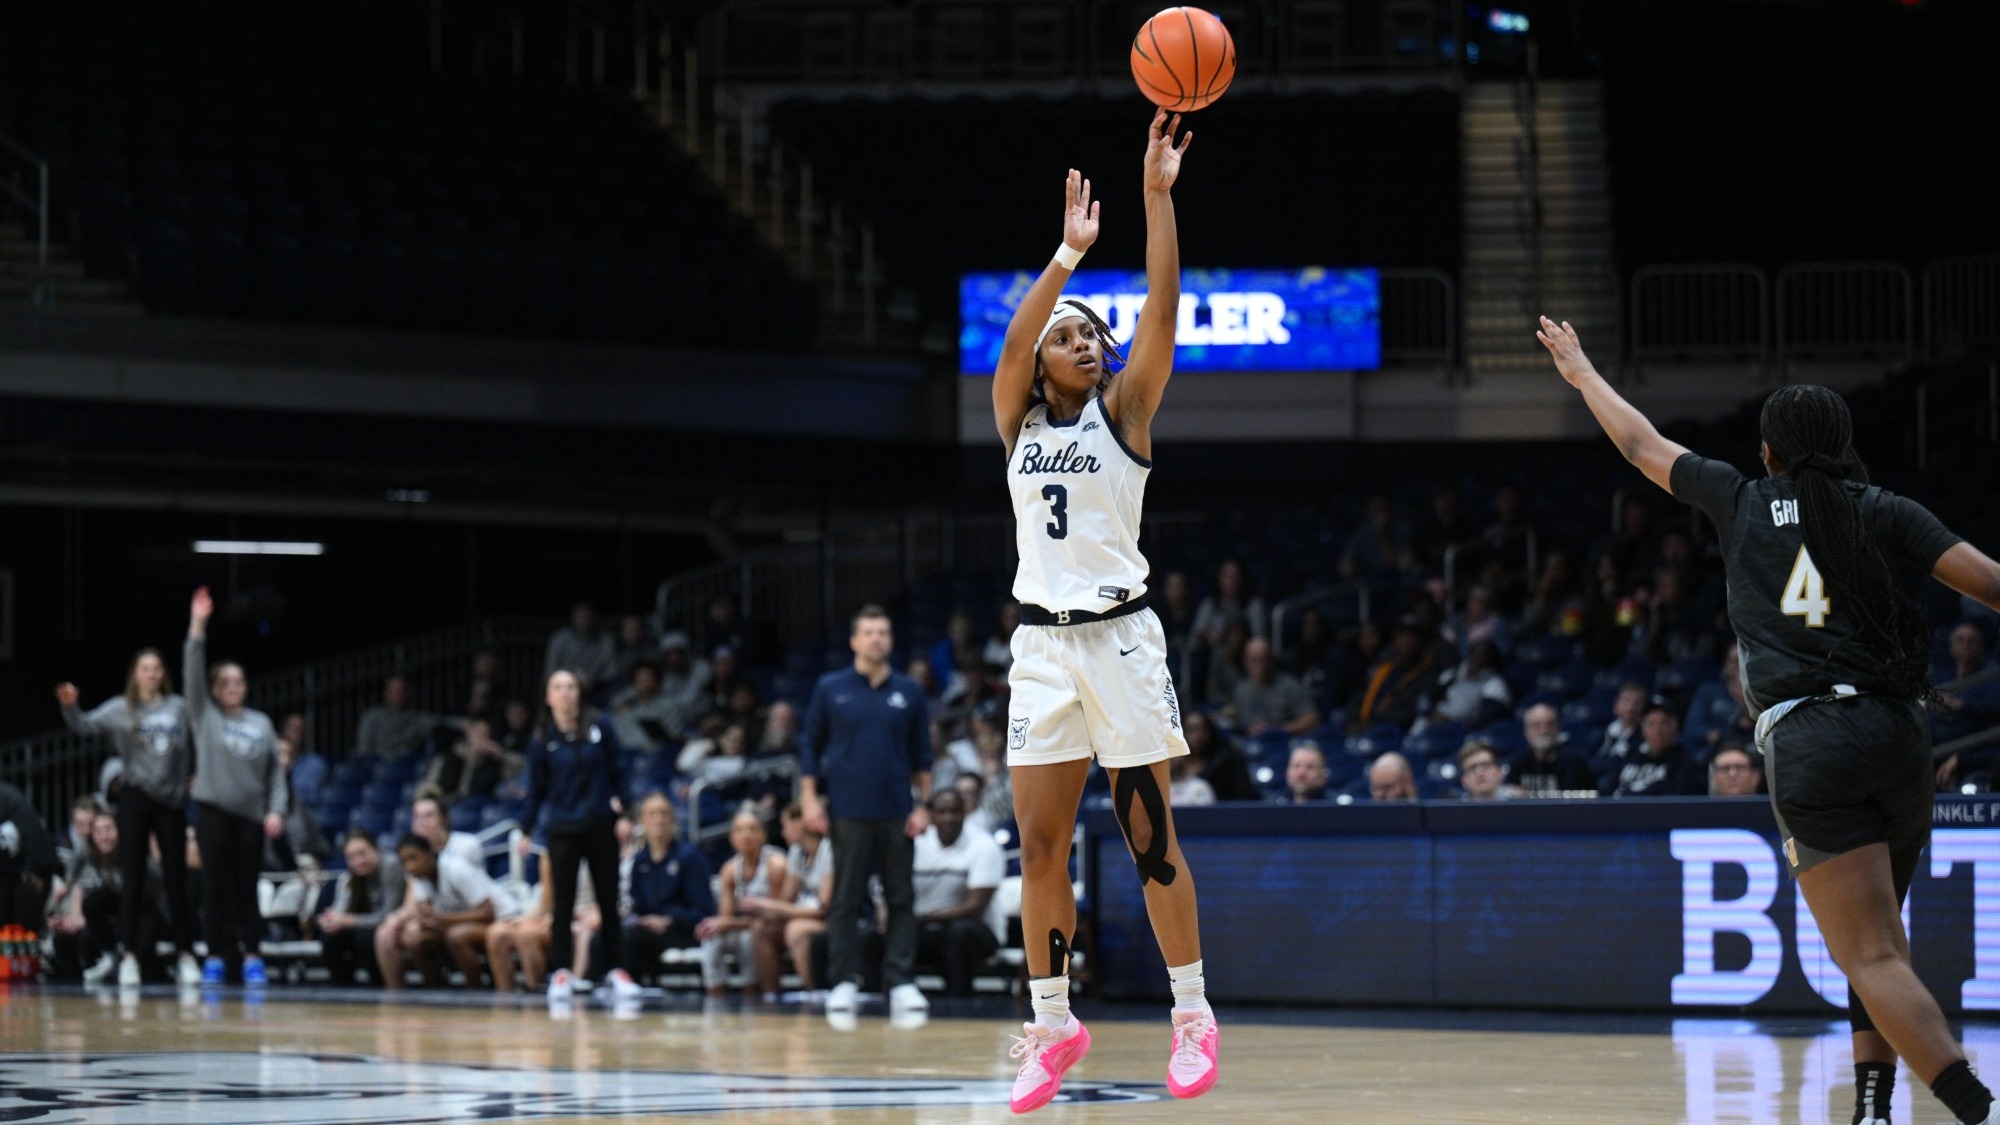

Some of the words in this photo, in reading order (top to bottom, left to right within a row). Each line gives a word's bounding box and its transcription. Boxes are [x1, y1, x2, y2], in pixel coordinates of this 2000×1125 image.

[1056, 292, 1291, 345] ULER
[1018, 441, 1101, 474] Butler
[1041, 484, 1068, 540] 3
[1770, 499, 1799, 527] GRI
[1780, 543, 1830, 628] 4
[1057, 610, 1071, 624] B
[1932, 803, 1985, 822] INKLE
